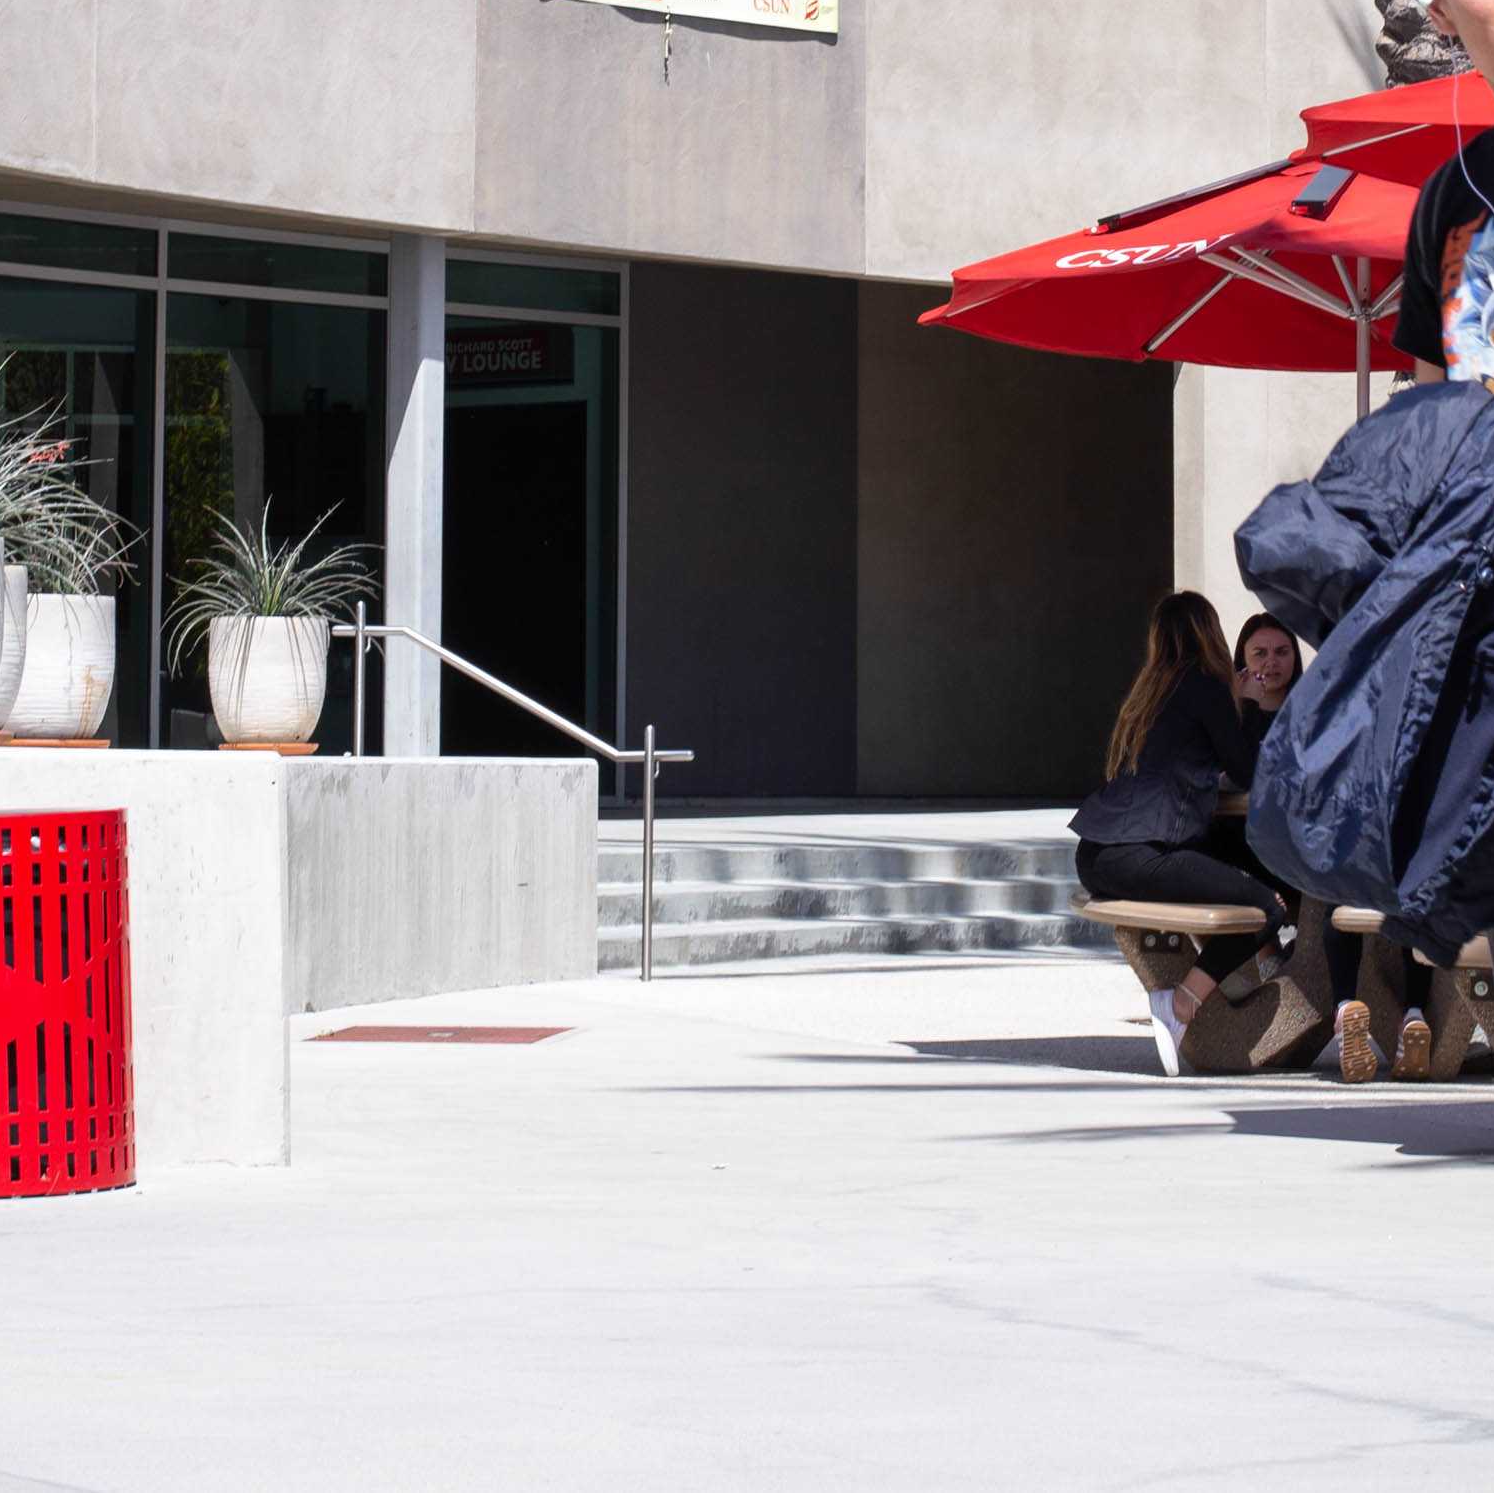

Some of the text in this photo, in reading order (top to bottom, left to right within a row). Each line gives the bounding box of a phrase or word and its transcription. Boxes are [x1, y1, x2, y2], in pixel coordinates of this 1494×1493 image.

[1055, 232, 1235, 269] CSUN
[497, 337, 533, 353] SCOTT
[461, 349, 543, 374] LOUNGE
